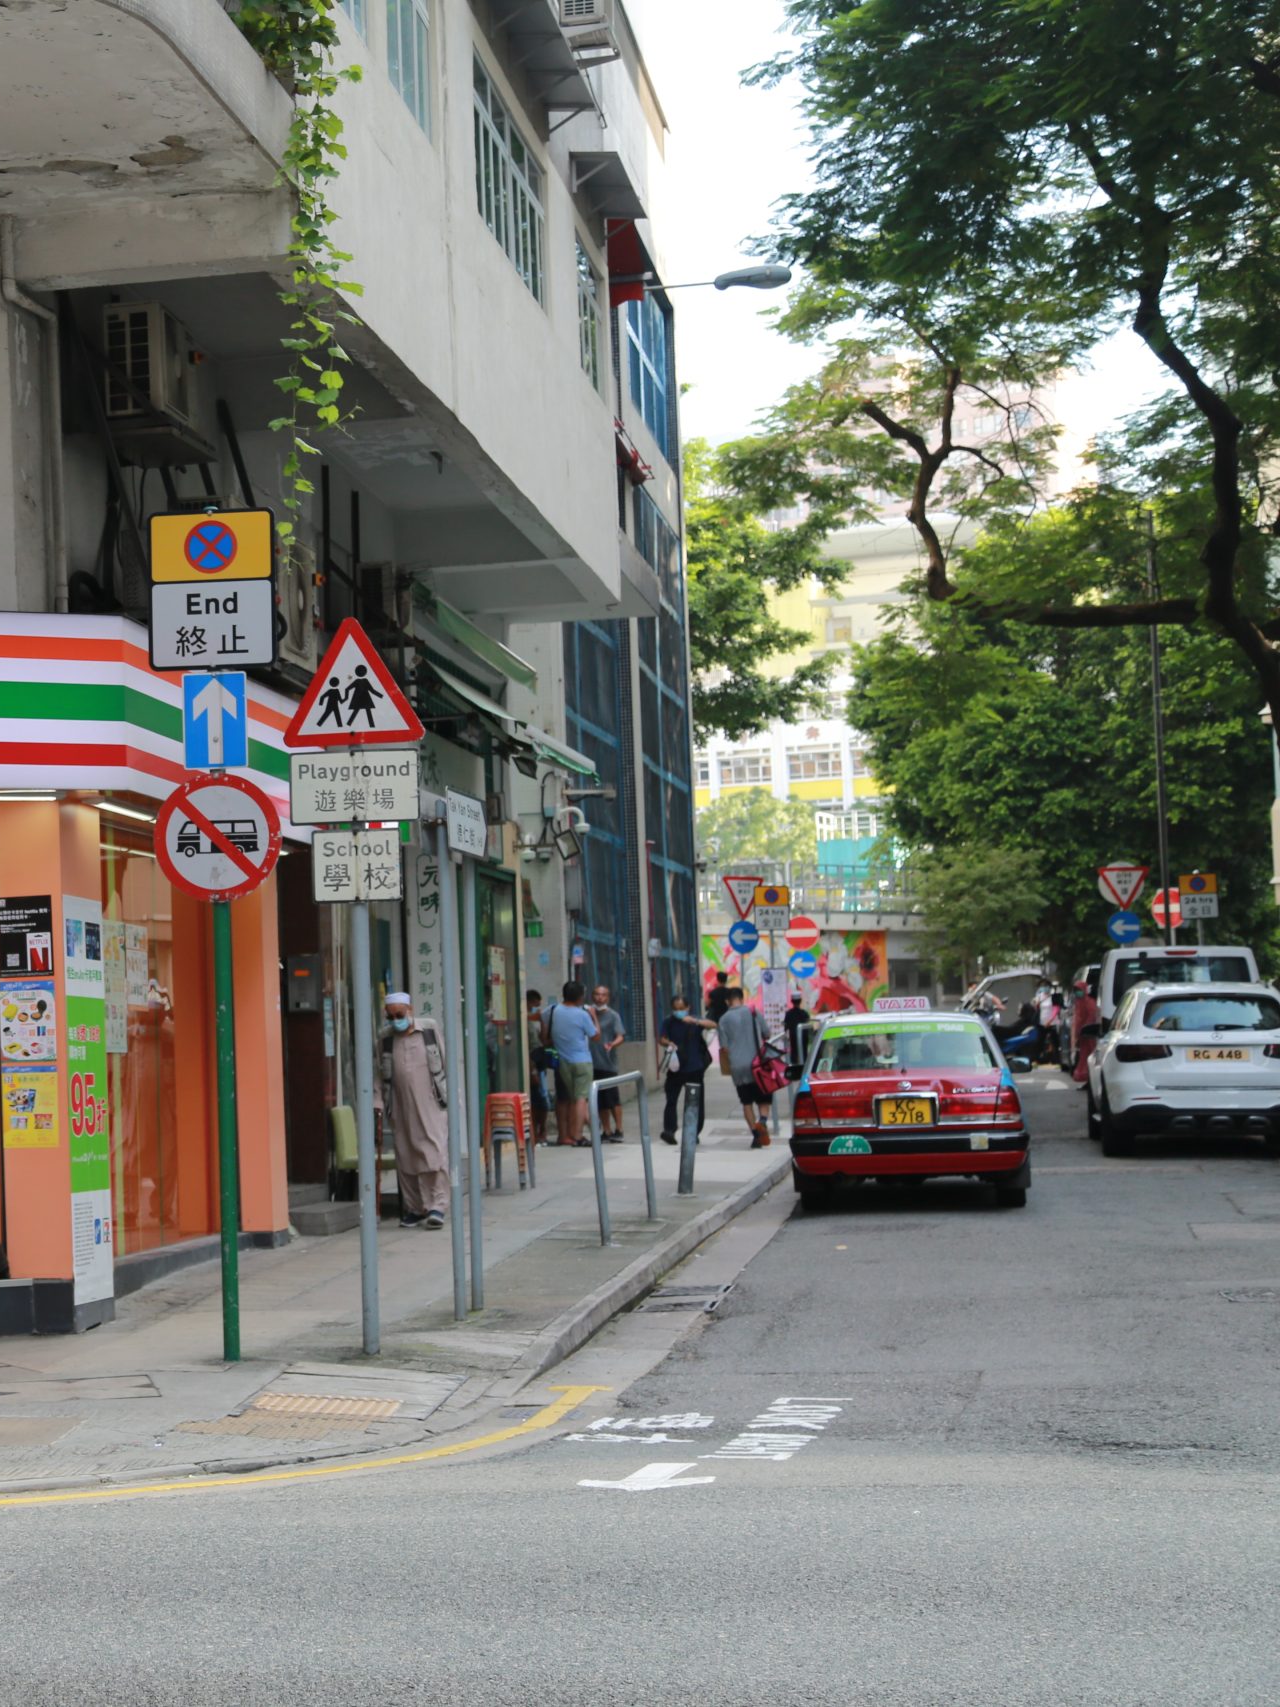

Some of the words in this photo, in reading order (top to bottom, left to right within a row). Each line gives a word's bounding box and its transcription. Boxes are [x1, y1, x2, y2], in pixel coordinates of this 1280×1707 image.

[186, 592, 239, 616] End
[175, 624, 249, 657] 終止
[298, 761, 410, 782] Playground
[314, 788, 395, 812] 遊樂場
[322, 840, 392, 857] School
[323, 862, 392, 892] 學校
[1184, 897, 1197, 905] 24
[1199, 896, 1213, 904] hrs
[1189, 906, 1211, 915] 全日
[876, 998, 926, 1009] TAXI
[1193, 1049, 1210, 1060] RG
[1216, 1049, 1243, 1060] 448
[895, 1100, 916, 1112] KC
[888, 1111, 925, 1124] 3718
[845, 1139, 854, 1148] 4
[747, 1397, 853, 1430] LOOK
